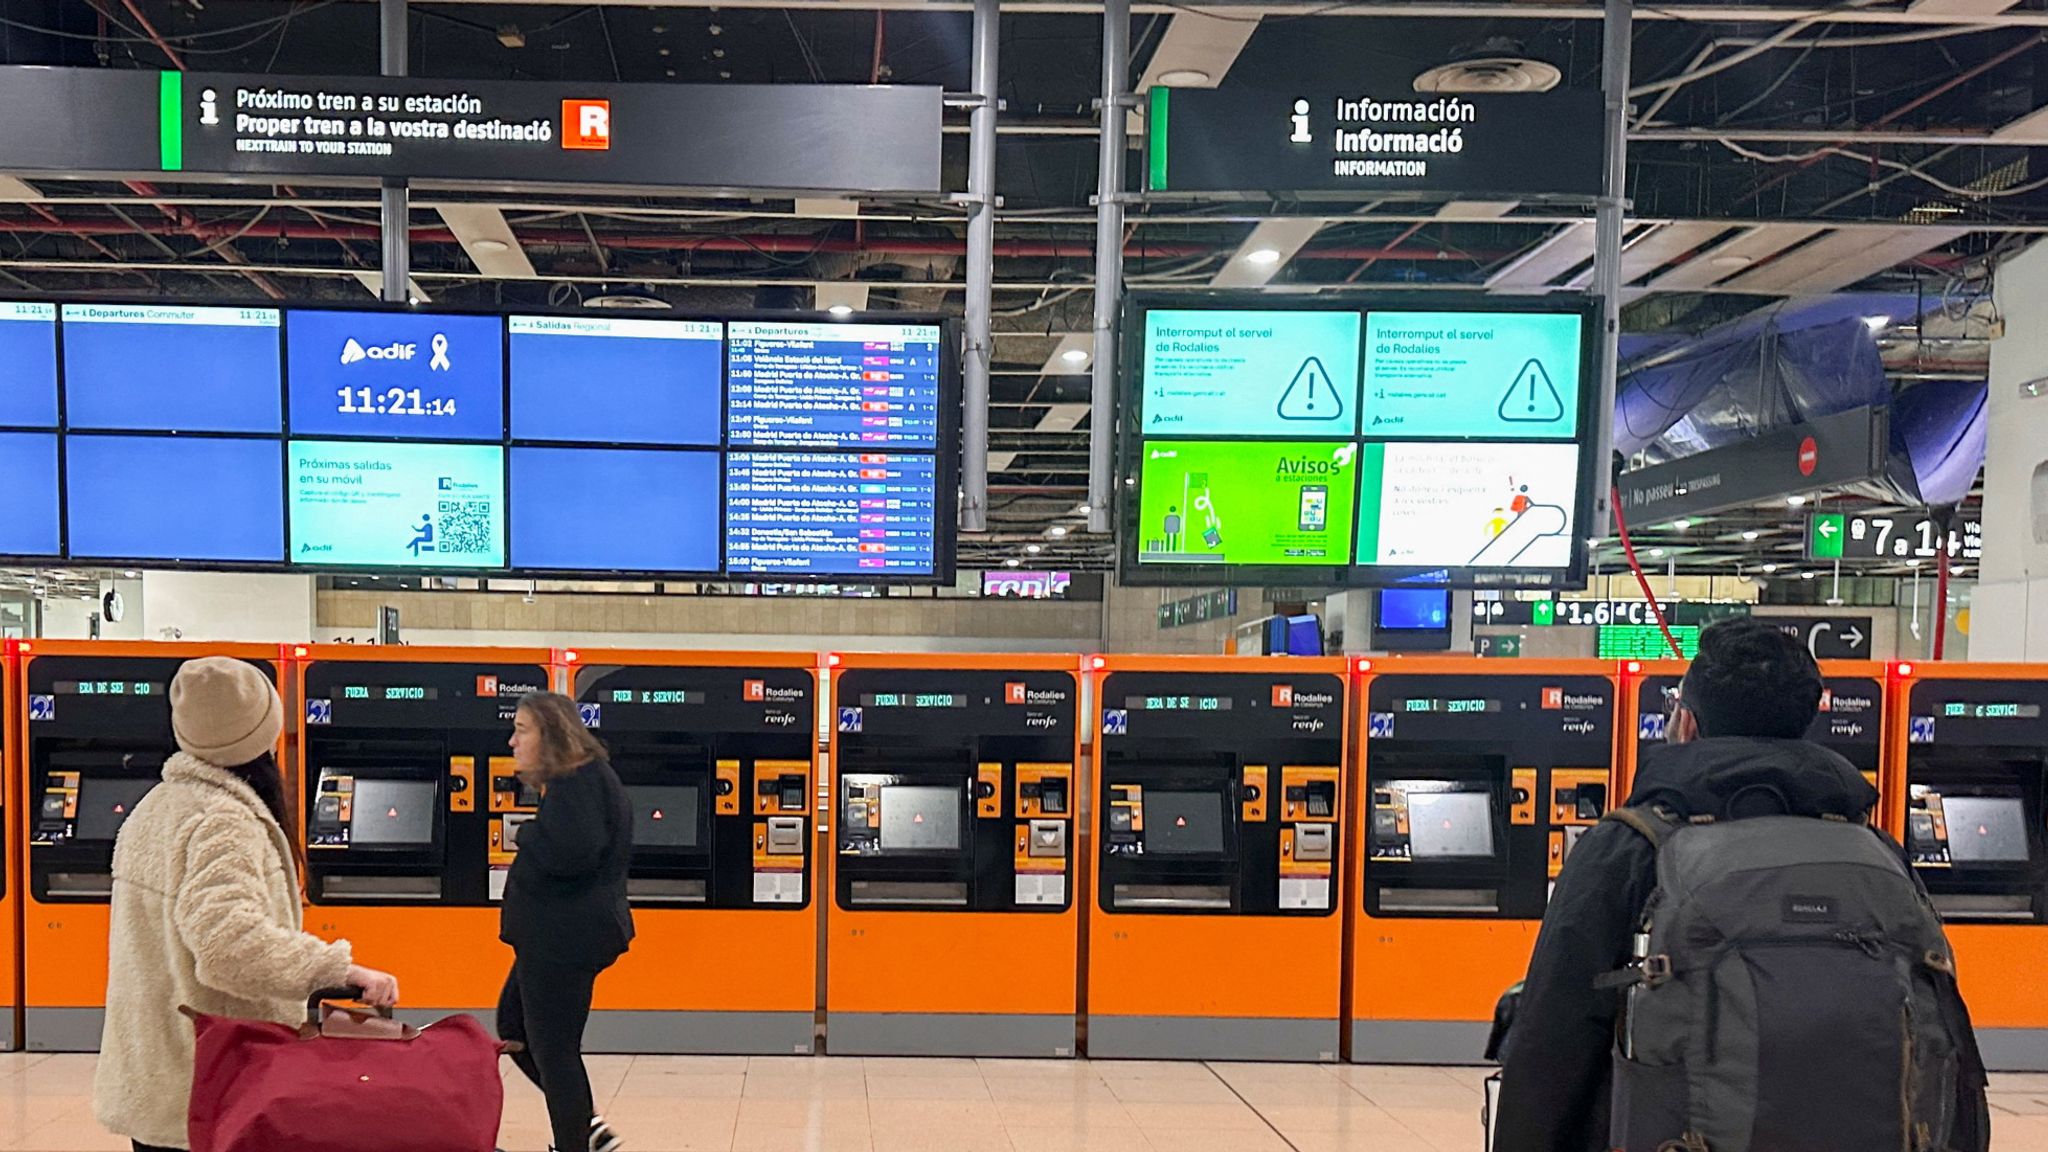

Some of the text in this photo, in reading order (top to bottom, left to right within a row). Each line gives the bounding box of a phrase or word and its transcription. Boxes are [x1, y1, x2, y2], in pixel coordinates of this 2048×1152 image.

[236, 88, 482, 114] Próximo tren a su estación
[1336, 98, 1475, 122] Información
[236, 114, 552, 141] Proper tren a la vostra destinació
[1335, 128, 1463, 153] Informació
[300, 140, 314, 153] TO
[316, 141, 346, 154] YOUR
[348, 142, 392, 156] STATION
[1334, 160, 1426, 177] INFORMATION
[89, 308, 195, 320] Departures Commuter
[536, 320, 572, 330] Salidas
[754, 327, 809, 336] Departures
[1156, 327, 1272, 339] Interromput el servei
[1377, 329, 1494, 341] Interromput el servei
[366, 343, 416, 360] adif
[1156, 343, 1219, 352] de Rodalies
[1376, 344, 1440, 354] de Rodalies
[909, 358, 916, 366] A
[908, 403, 915, 412] A
[299, 459, 392, 471] Próximas salidas
[1276, 455, 1341, 476] Avisos
[300, 475, 362, 485] en su móvil
[1284, 474, 1328, 482] estaciones
[1633, 488, 1644, 506] No
[1872, 519, 1893, 555] 7
[1894, 538, 1908, 556] a
[1594, 603, 1610, 624] 6
[1480, 639, 1490, 653] P
[97, 682, 107, 693] DE
[345, 687, 424, 699] FUERA SERVICIO
[499, 685, 537, 693] Rodalies
[766, 688, 803, 697] Rodalies
[875, 695, 952, 707] FUERA SERVICIO
[1027, 691, 1065, 699] Rodalies
[1294, 693, 1333, 703] Rodalies
[1564, 695, 1603, 705] Rodalies
[1166, 698, 1176, 709] DE
[1406, 700, 1485, 712] FUERA SERVICIO
[1832, 697, 1871, 708] Rodalies
[765, 713, 795, 726] renfe
[1026, 715, 1057, 729] renfe
[1293, 719, 1324, 732] renfe
[1563, 721, 1595, 735] renfe
[1831, 724, 1863, 736] renfe
